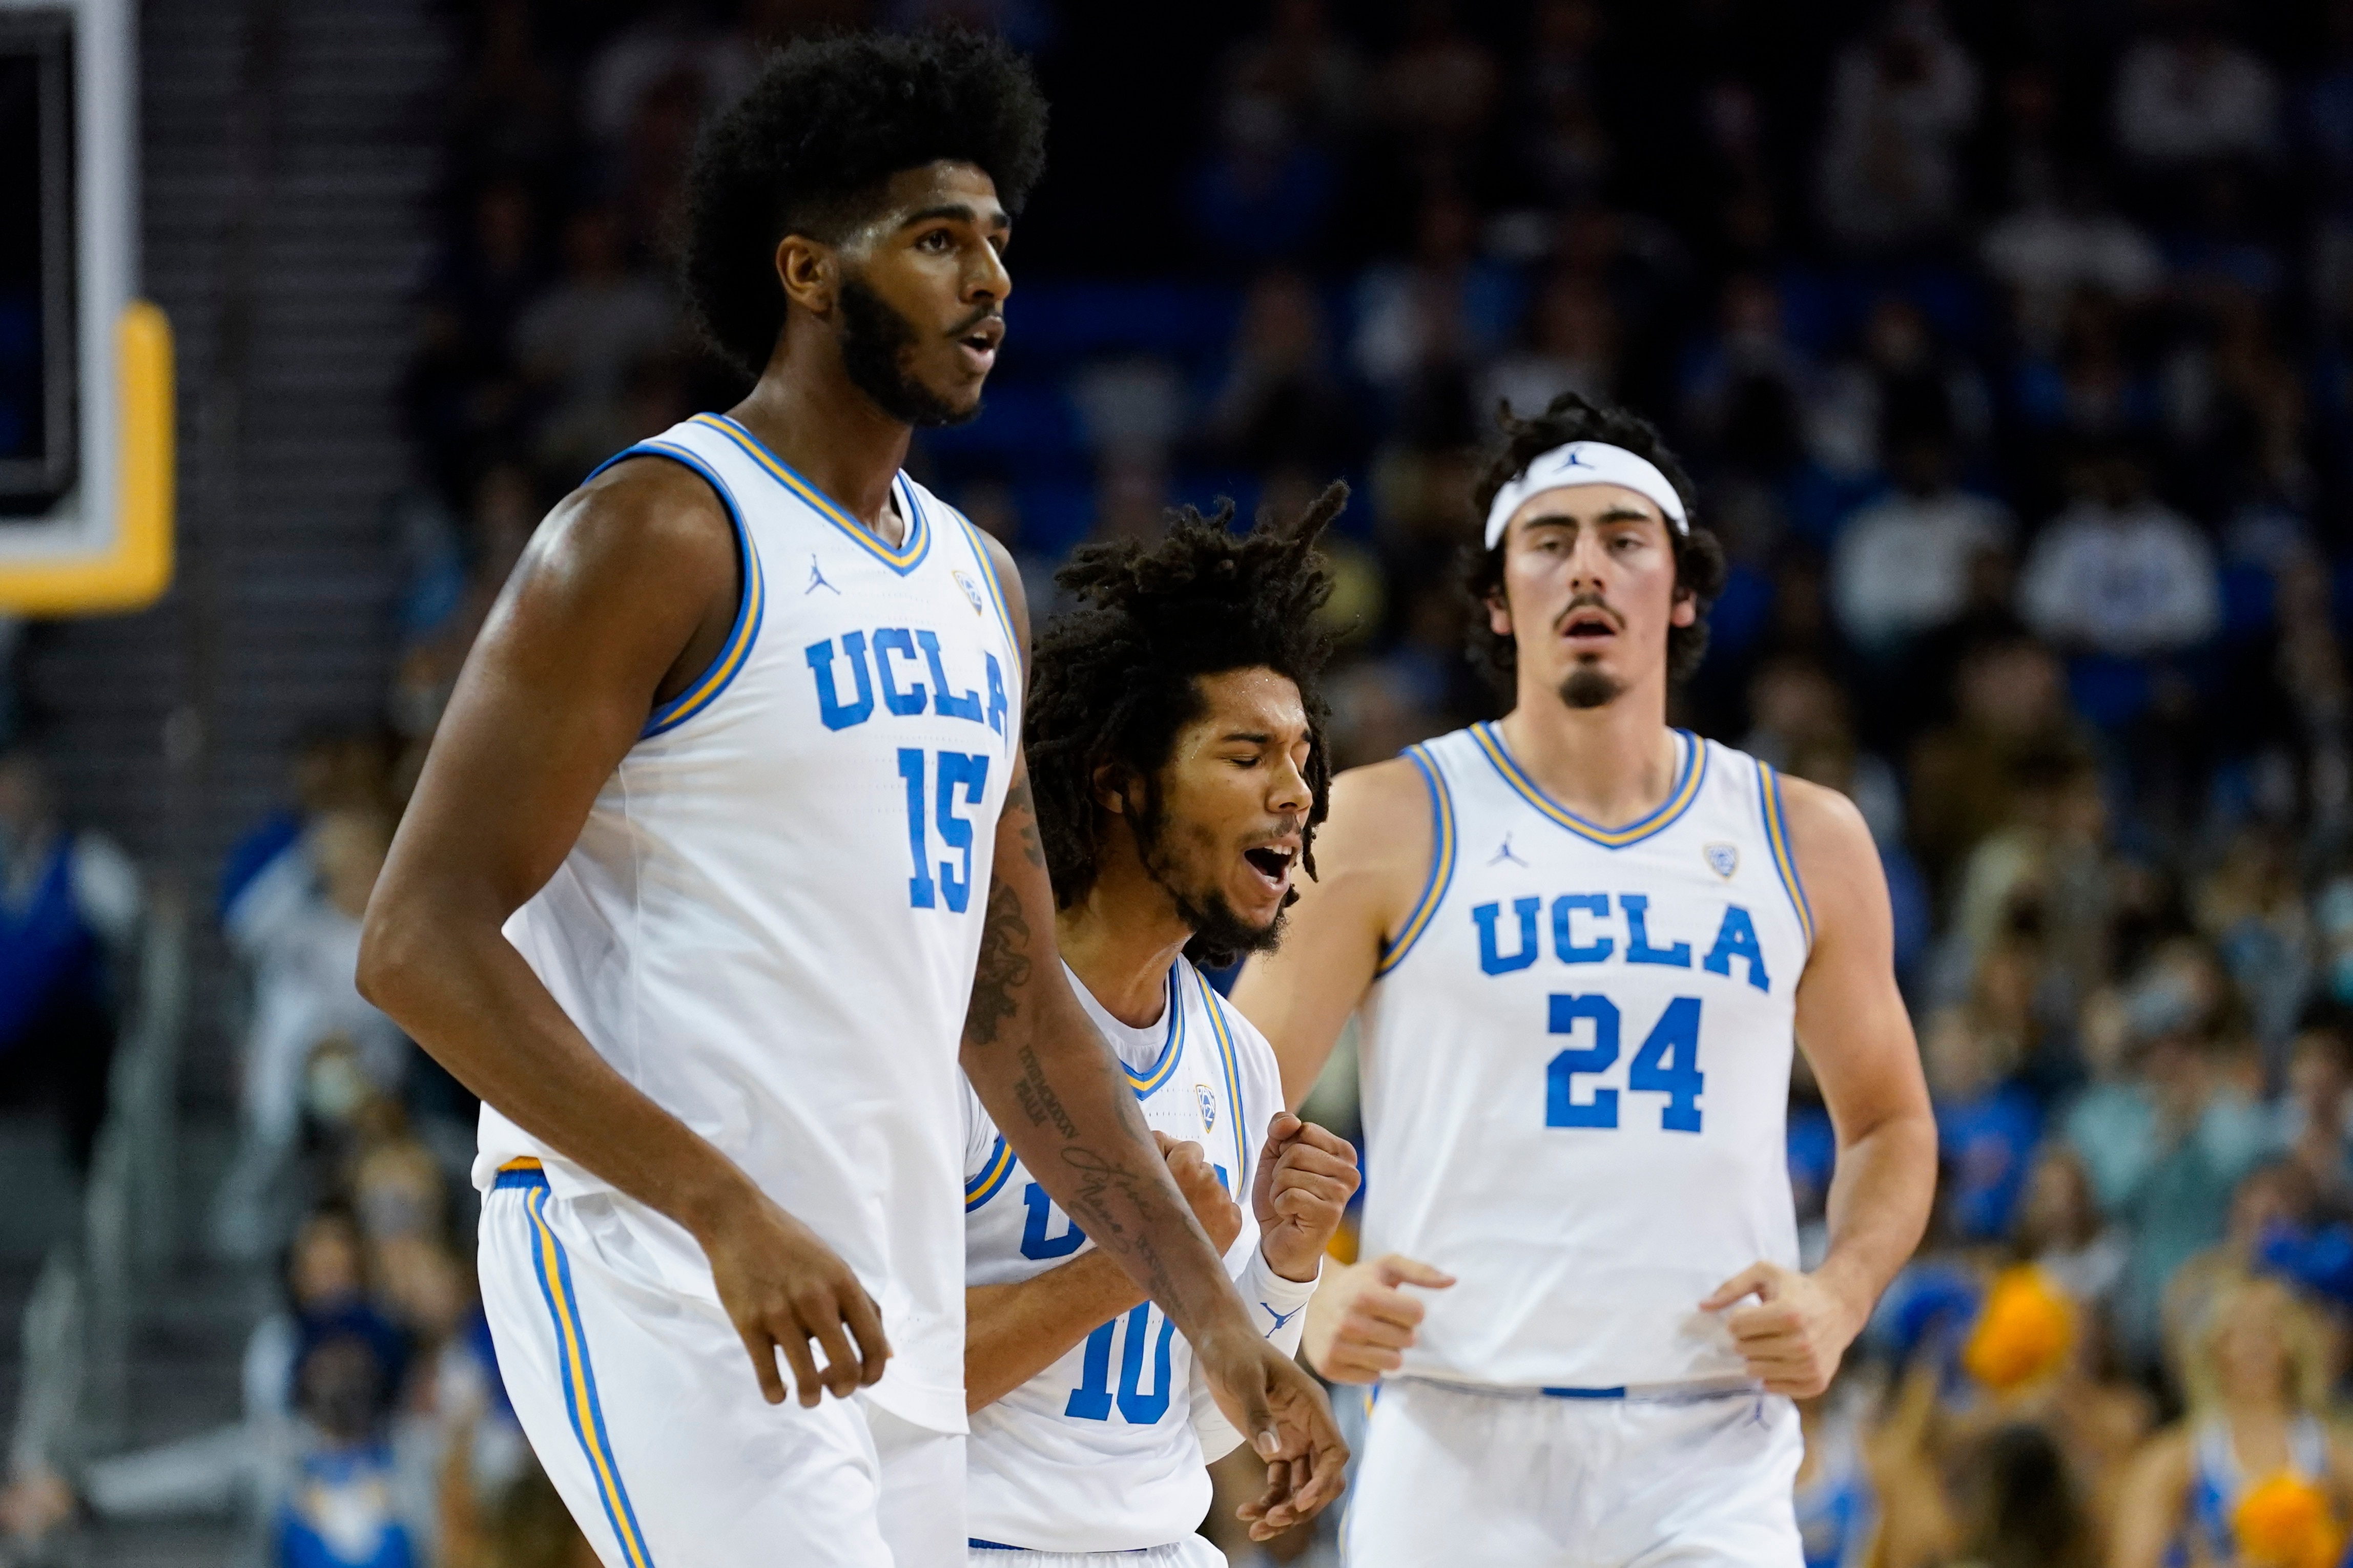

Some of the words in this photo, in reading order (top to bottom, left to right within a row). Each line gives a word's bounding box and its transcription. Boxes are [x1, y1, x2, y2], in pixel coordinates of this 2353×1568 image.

[804, 628, 1008, 758] UCLA
[897, 748, 990, 914] 15
[1471, 892, 1770, 994] UCLA
[1202, 1104, 1214, 1122] 12
[1544, 993, 1705, 1134] 24
[1064, 1301, 1175, 1426] 10
